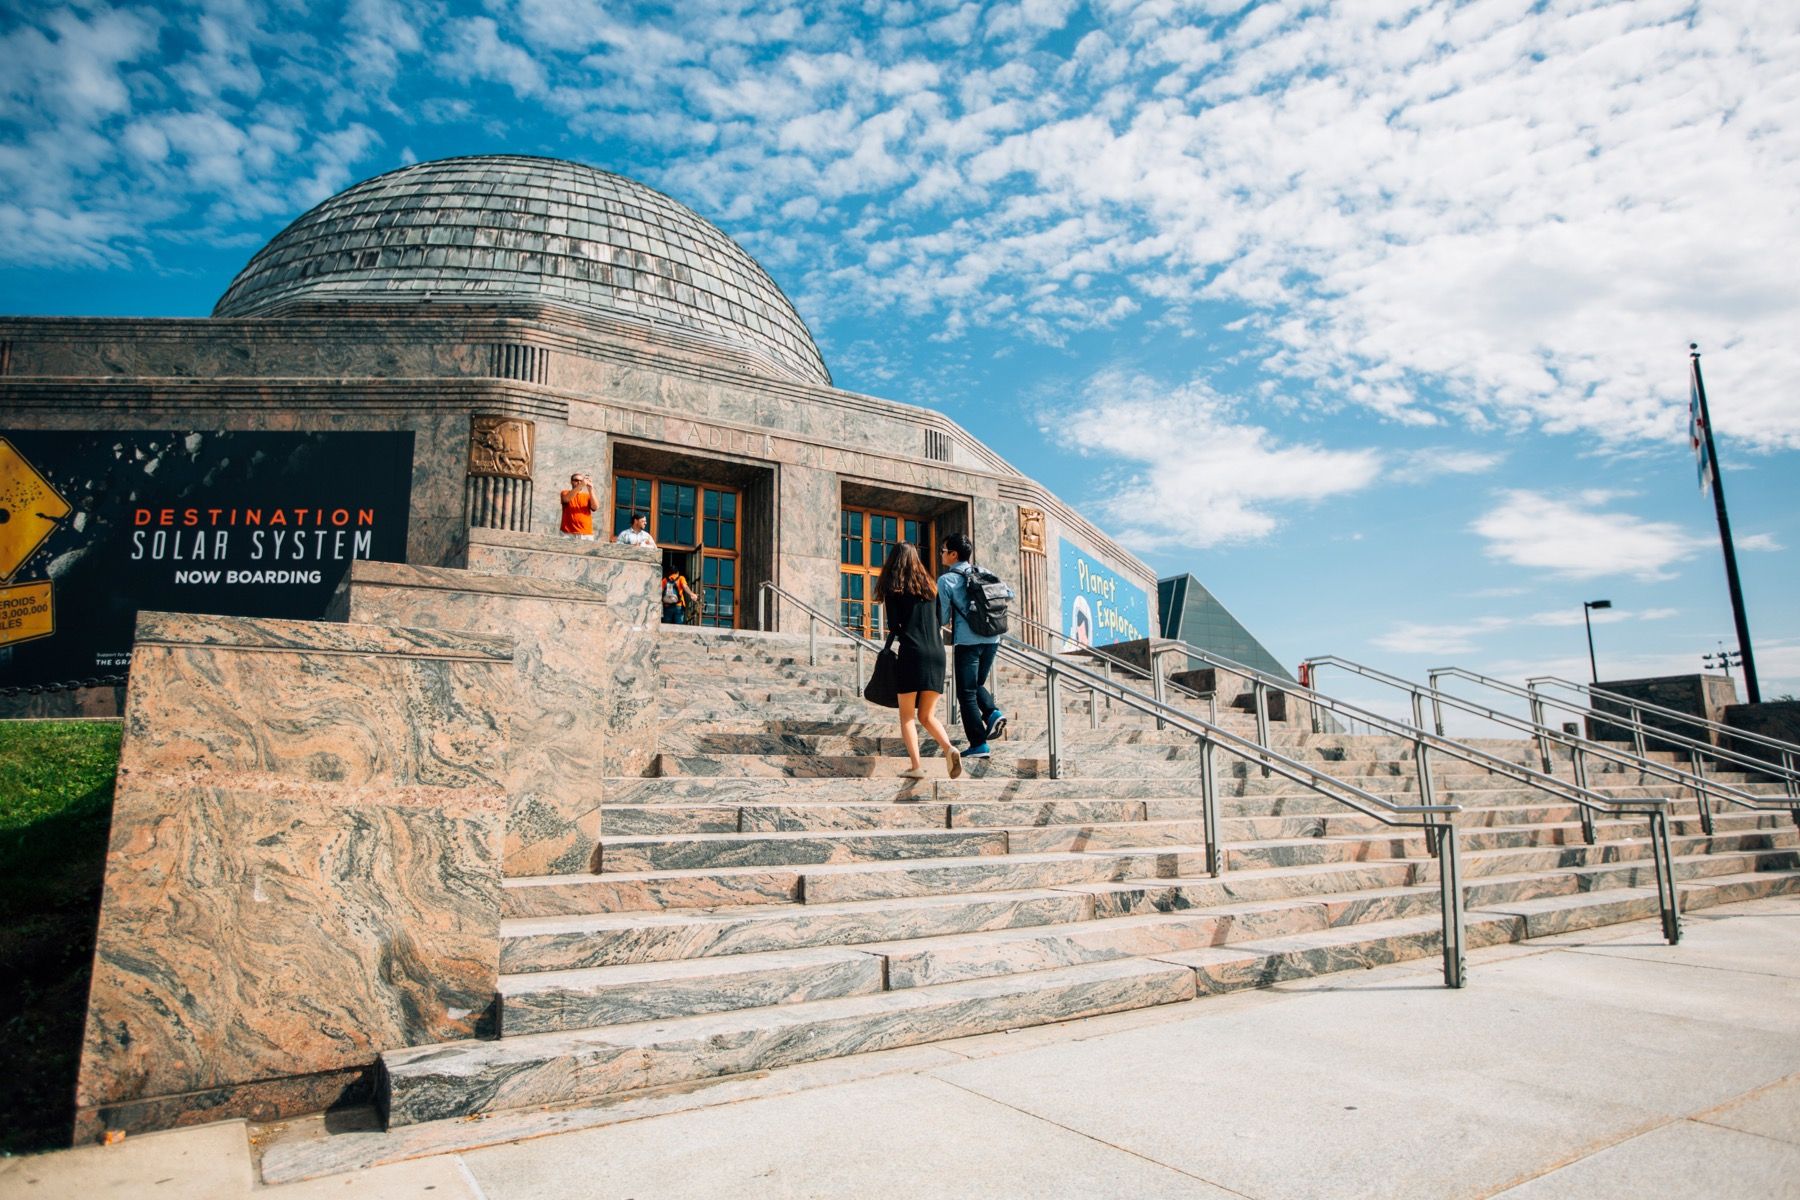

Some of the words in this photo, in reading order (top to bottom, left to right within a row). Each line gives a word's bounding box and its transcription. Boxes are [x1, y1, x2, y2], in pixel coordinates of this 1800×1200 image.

[601, 407, 653, 435] THE
[688, 423, 777, 457] ADLER
[800, 446, 978, 492] PLANETARIUM
[134, 508, 374, 525] DESTINATION
[131, 530, 228, 560] SOLAR
[250, 530, 372, 560] SYSTEM
[175, 570, 220, 584] NOW
[226, 570, 321, 584] BOARDING
[1077, 558, 1115, 602] Planet
